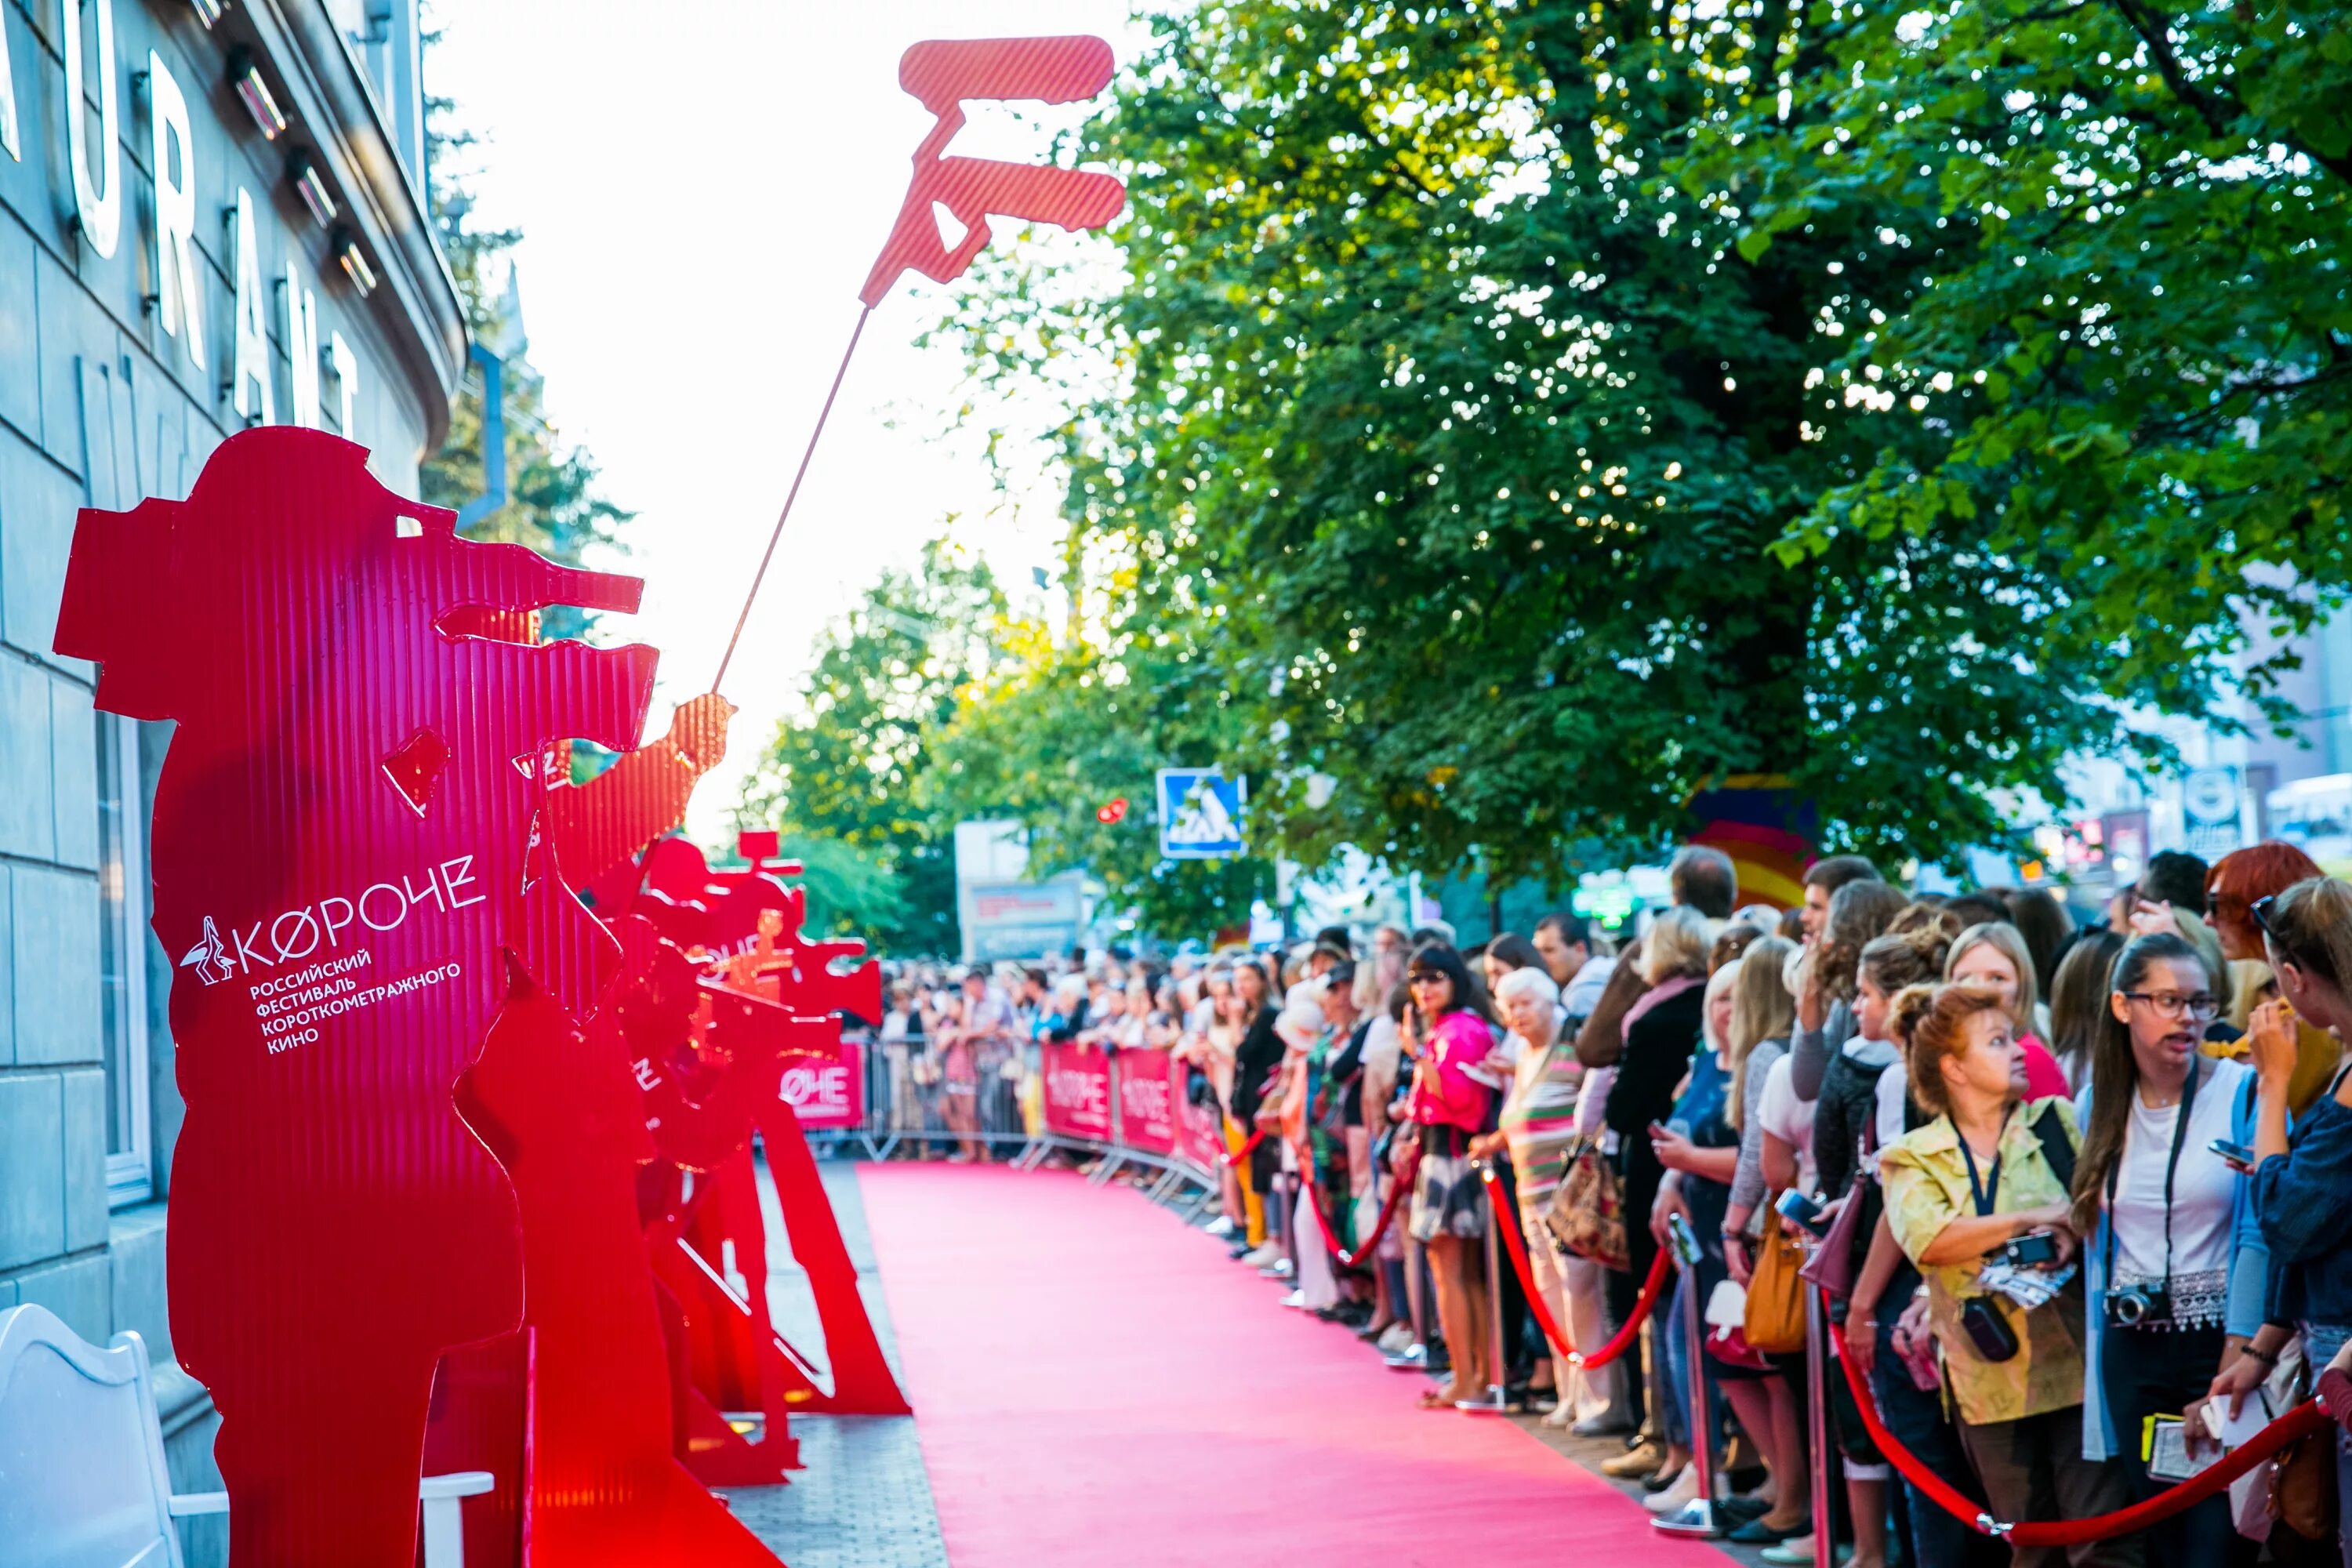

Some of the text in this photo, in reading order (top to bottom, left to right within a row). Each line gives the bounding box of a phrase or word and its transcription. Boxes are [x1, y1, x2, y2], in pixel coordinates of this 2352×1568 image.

[249, 948, 372, 1000] РОССИЙСКИЙ
[256, 977, 357, 1018] ФЕСТИВАЛЬ
[261, 963, 461, 1036] КОРОТКОМЕТРАЖНОГО
[267, 1028, 319, 1054] КИНО
